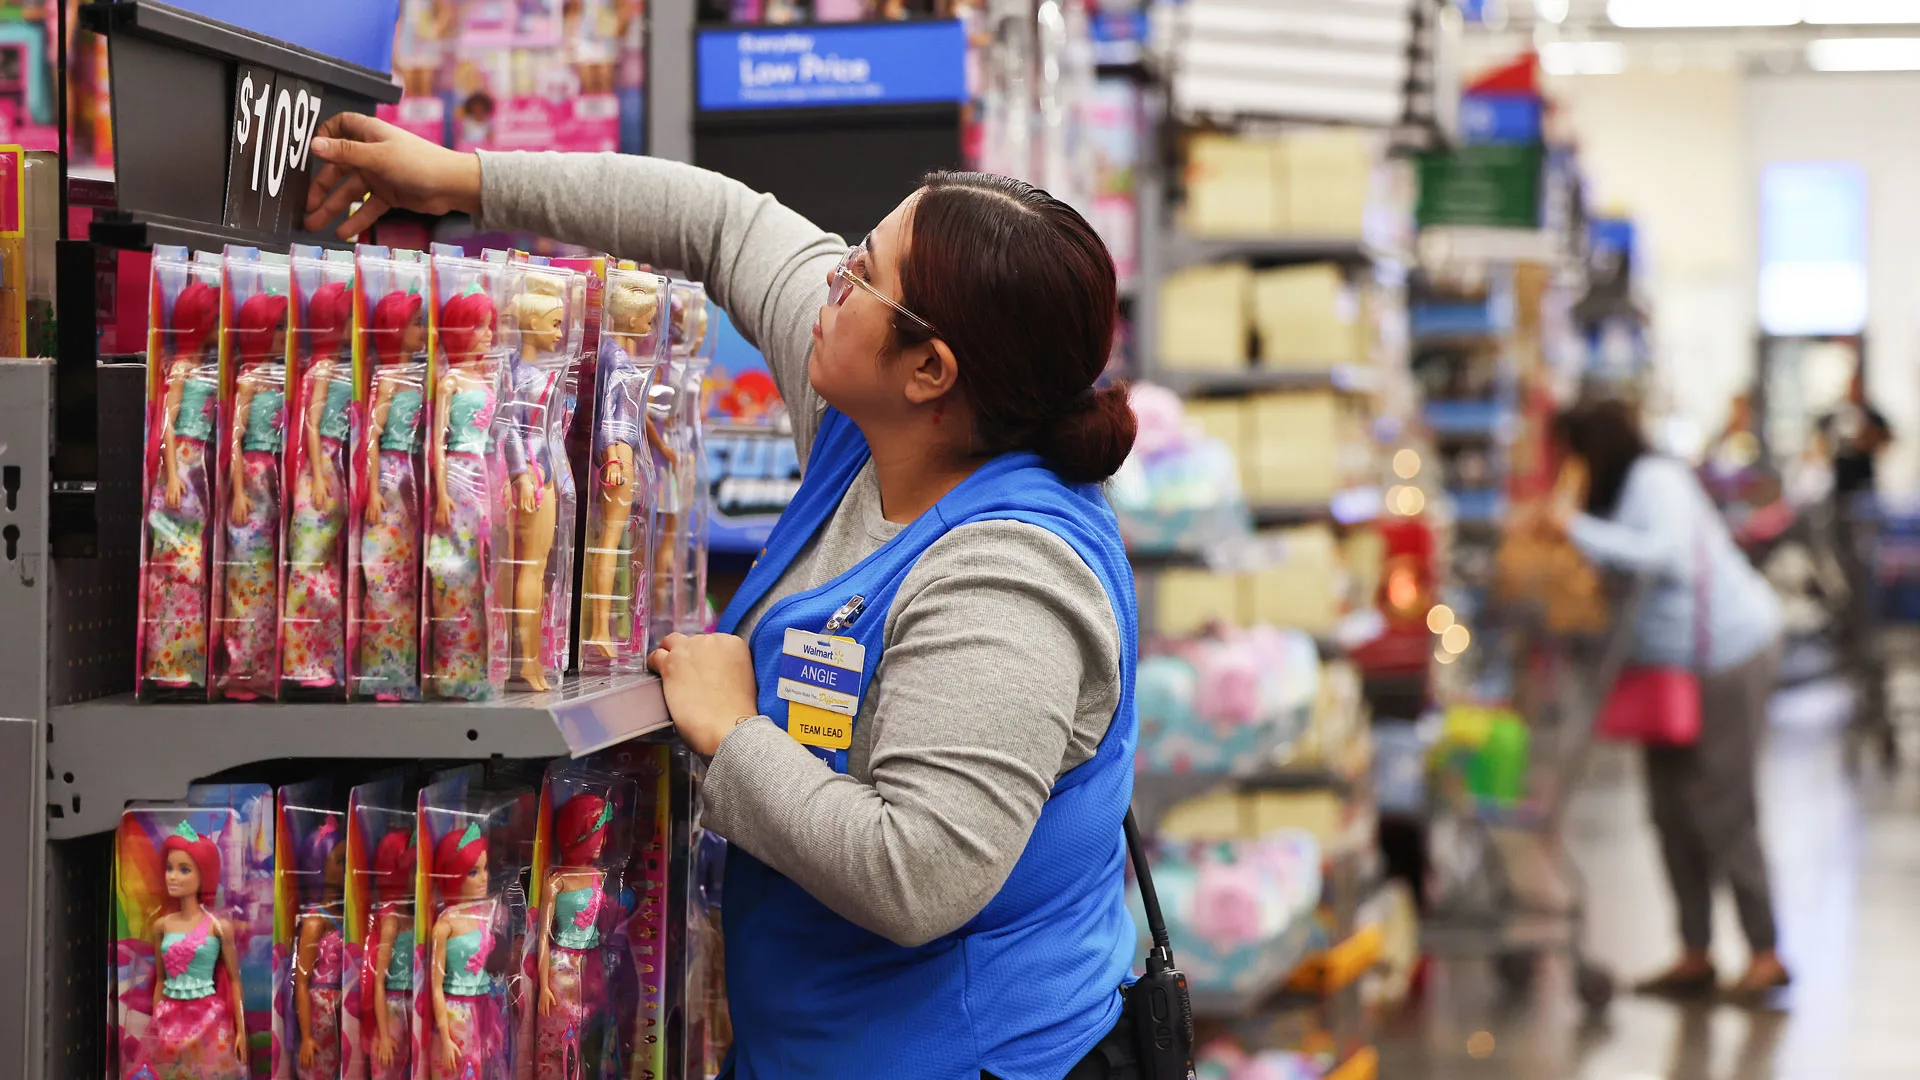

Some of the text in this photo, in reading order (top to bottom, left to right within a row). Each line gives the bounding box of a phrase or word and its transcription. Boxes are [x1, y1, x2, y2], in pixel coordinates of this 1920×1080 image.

[738, 33, 814, 55] Everyday
[739, 52, 871, 86] Low Price
[803, 644, 834, 660] Walmart
[801, 664, 838, 686] ANGIE
[800, 723, 843, 738] TEAM LEAD
